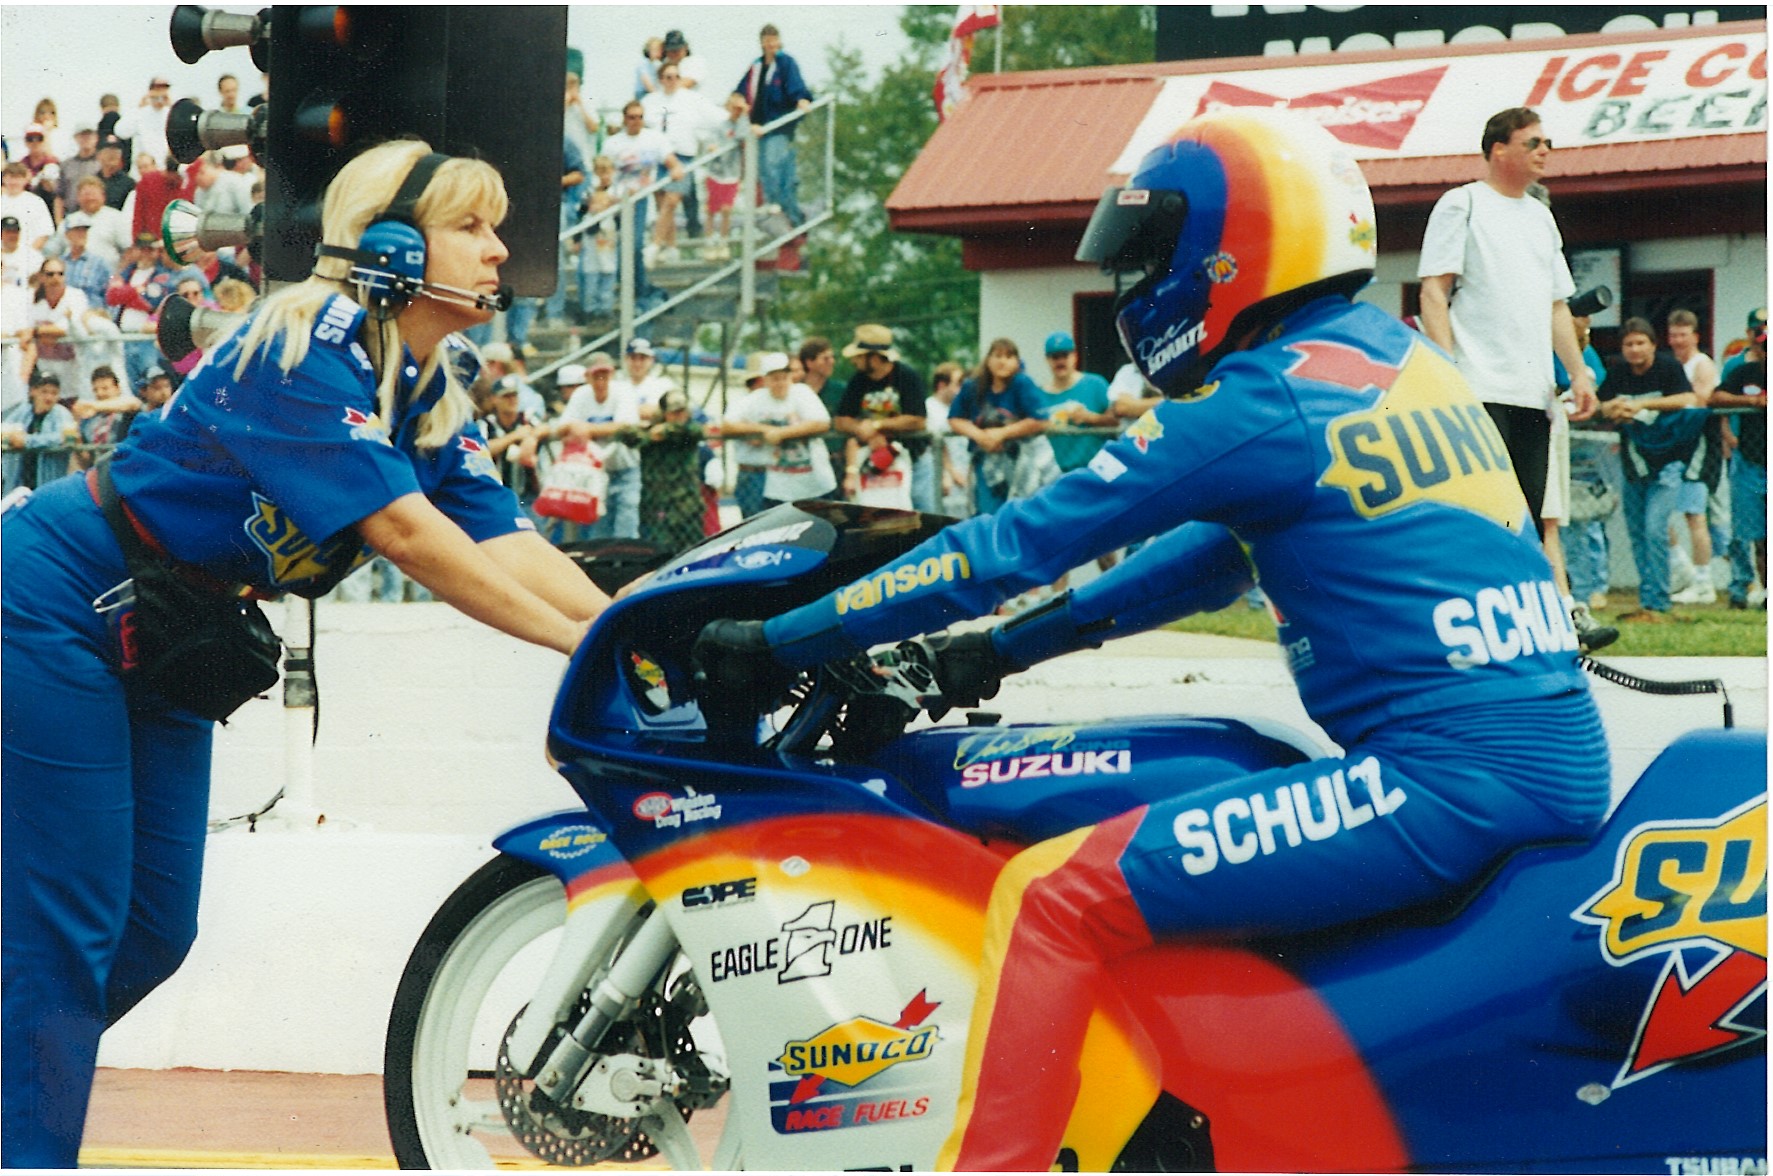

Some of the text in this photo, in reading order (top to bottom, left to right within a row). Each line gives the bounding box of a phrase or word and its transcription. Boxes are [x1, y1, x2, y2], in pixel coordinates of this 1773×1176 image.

[1523, 50, 1670, 107] ICE
[835, 551, 971, 615] vanson
[1432, 580, 1579, 670] SCHUL
[961, 750, 1132, 789] SUZUKI
[711, 938, 778, 983] EAGLE
[840, 917, 892, 955] ONE
[790, 1031, 931, 1071] SUNOCO
[785, 1097, 930, 1131] RACE FUELS
